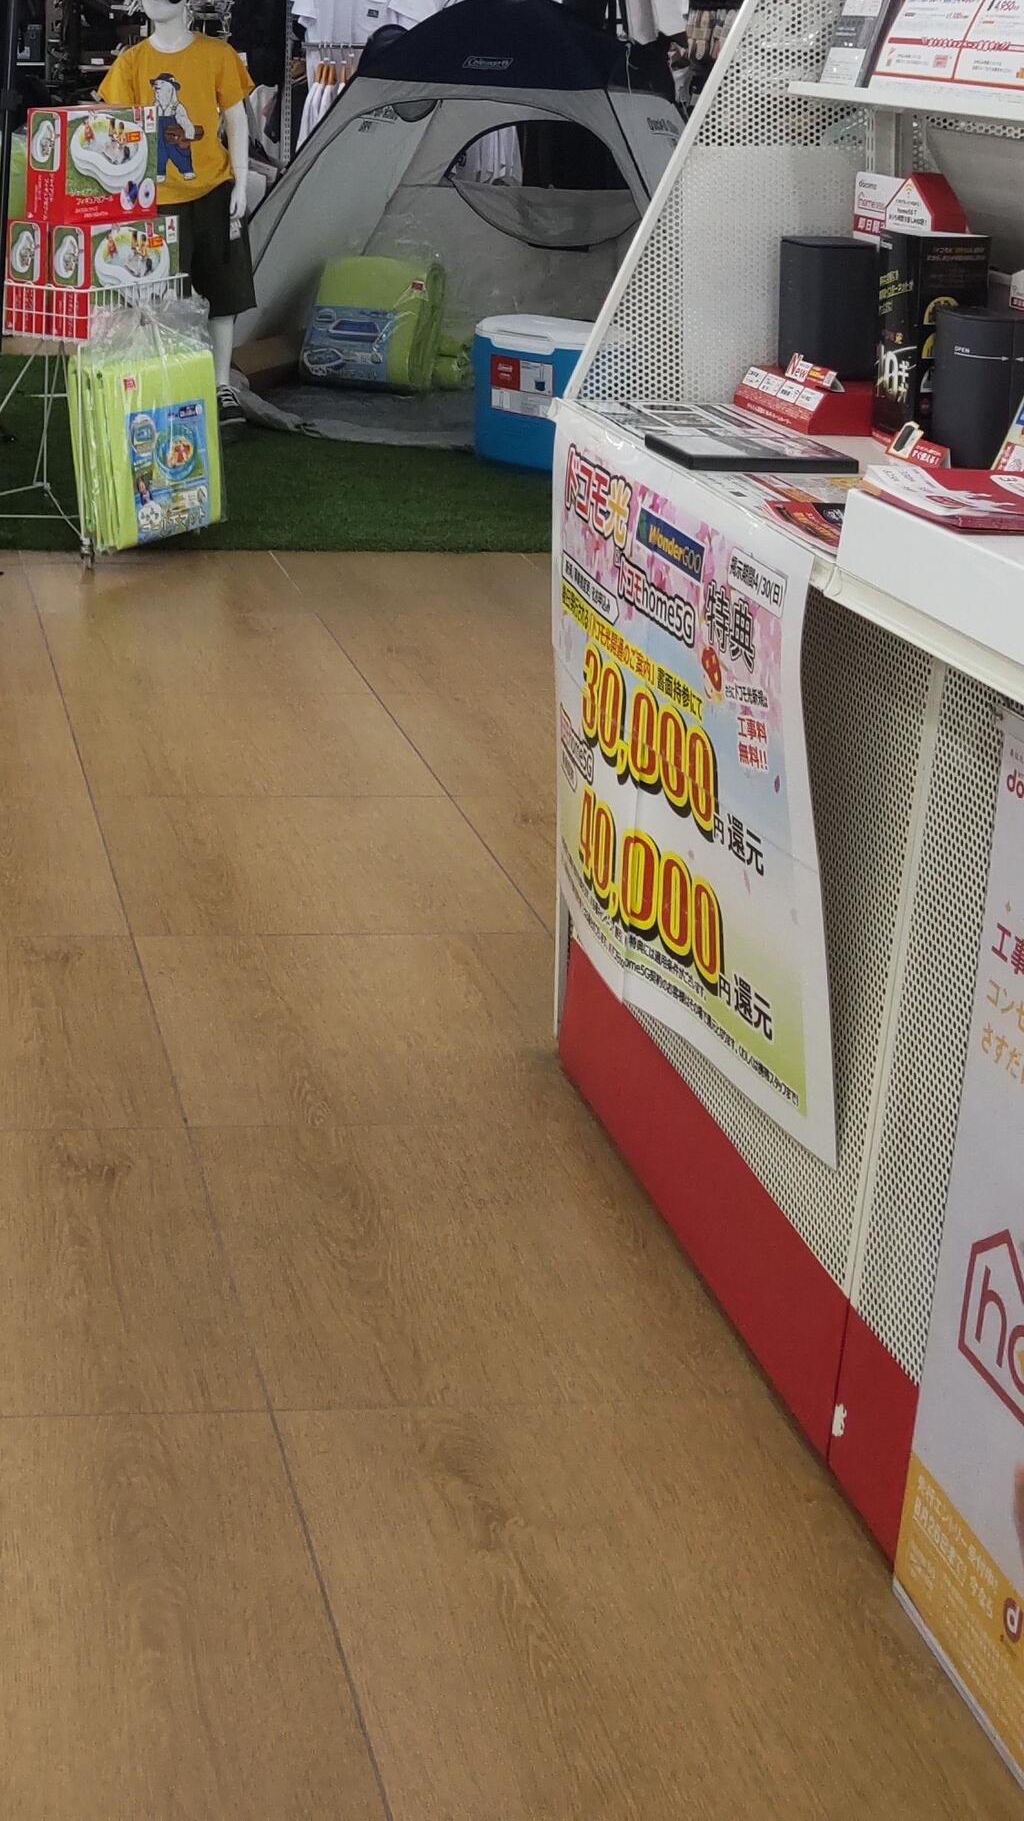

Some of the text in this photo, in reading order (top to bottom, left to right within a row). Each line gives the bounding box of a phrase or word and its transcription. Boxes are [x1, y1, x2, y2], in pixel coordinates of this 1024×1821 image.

[787, 353, 807, 379] New
[954, 345, 970, 354] OPEN
[565, 444, 632, 551] ドコモ光
[648, 525, 702, 575] WonderGOO
[617, 554, 696, 649] ドコモhome5G
[704, 580, 755, 674] 特典
[737, 716, 767, 743] 工事料
[738, 744, 768, 770] 無料!!
